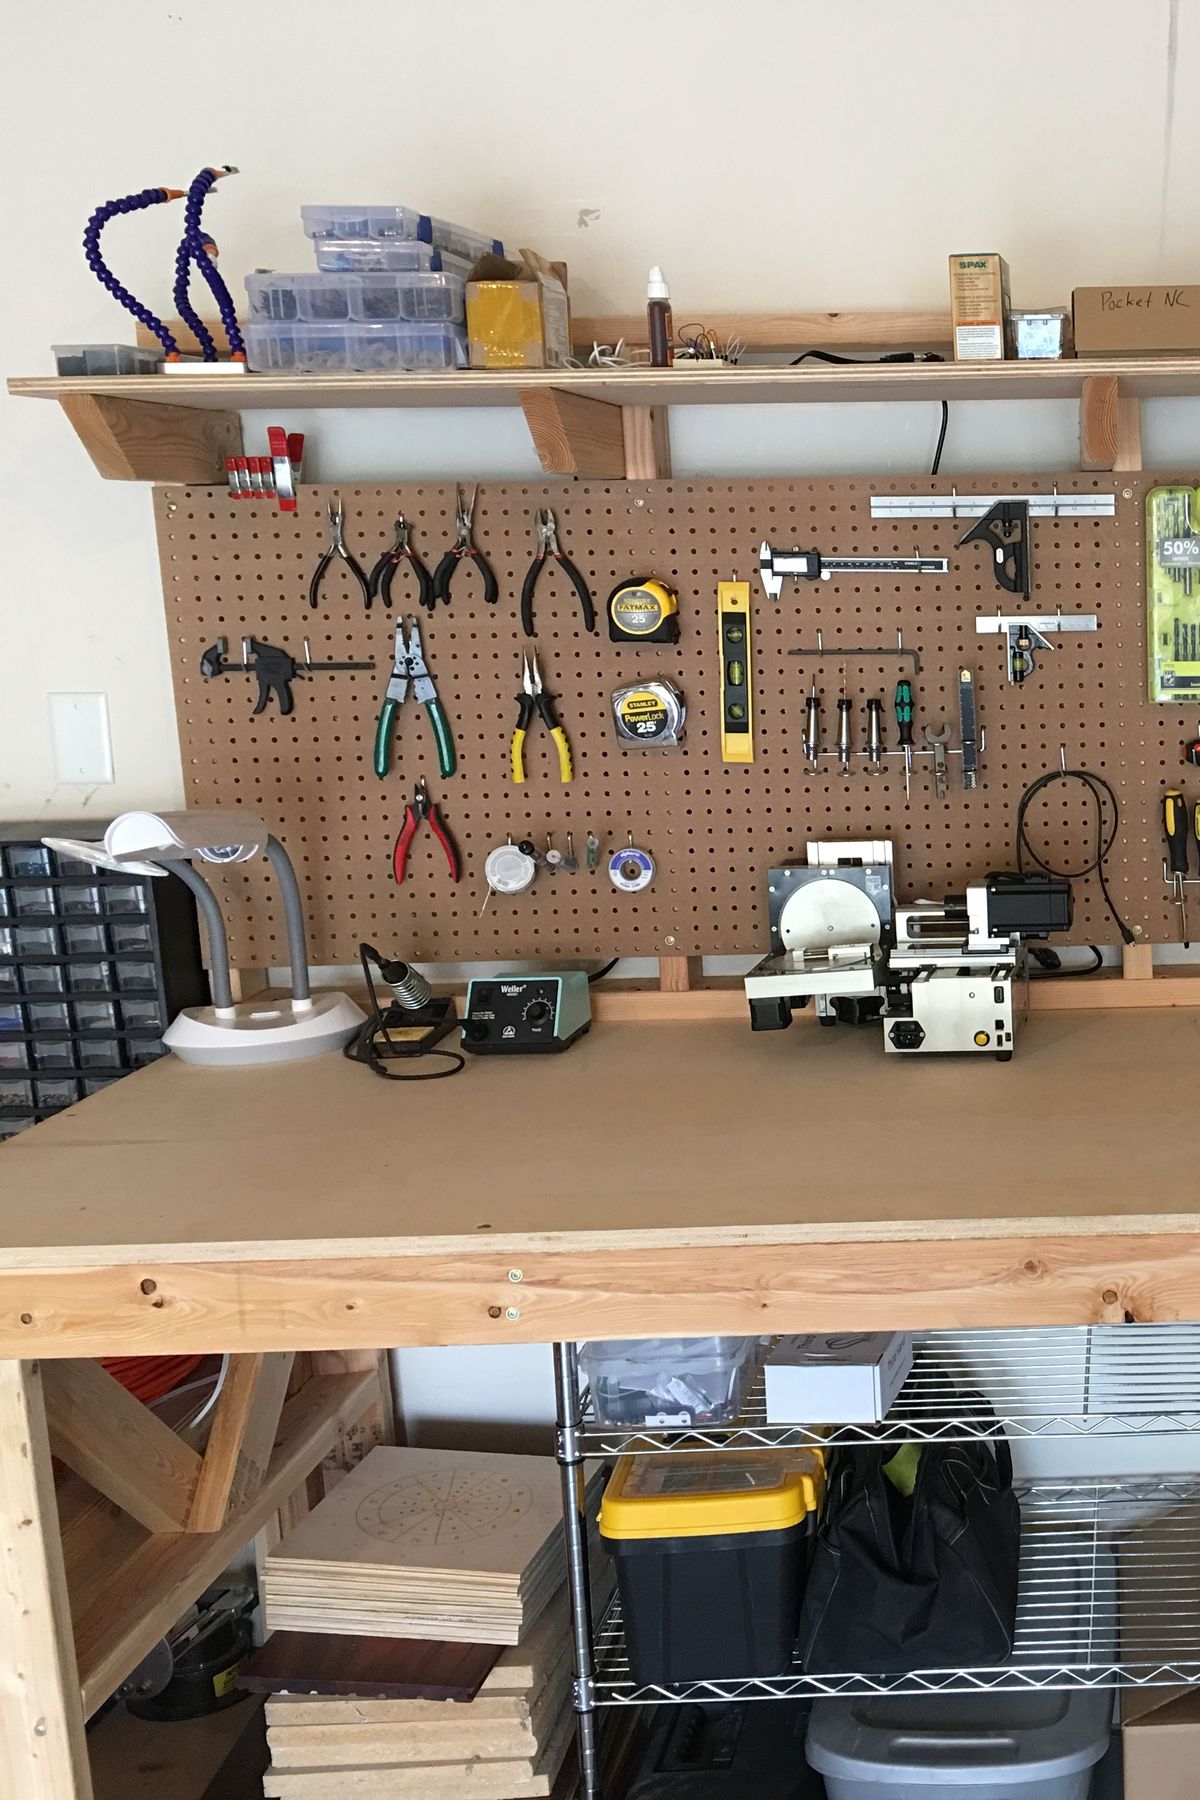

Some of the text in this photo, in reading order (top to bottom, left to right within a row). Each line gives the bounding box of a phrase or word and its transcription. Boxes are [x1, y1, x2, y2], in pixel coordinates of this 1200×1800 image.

[959, 261, 987, 269] SPAX
[1101, 291, 1152, 311] Pocket
[1164, 289, 1191, 307] NC
[1163, 540, 1199, 555] 50%
[632, 614, 646, 623] 25
[629, 700, 656, 708] STANLEY
[624, 711, 665, 722] PowerLock
[501, 985, 524, 993] Weller
